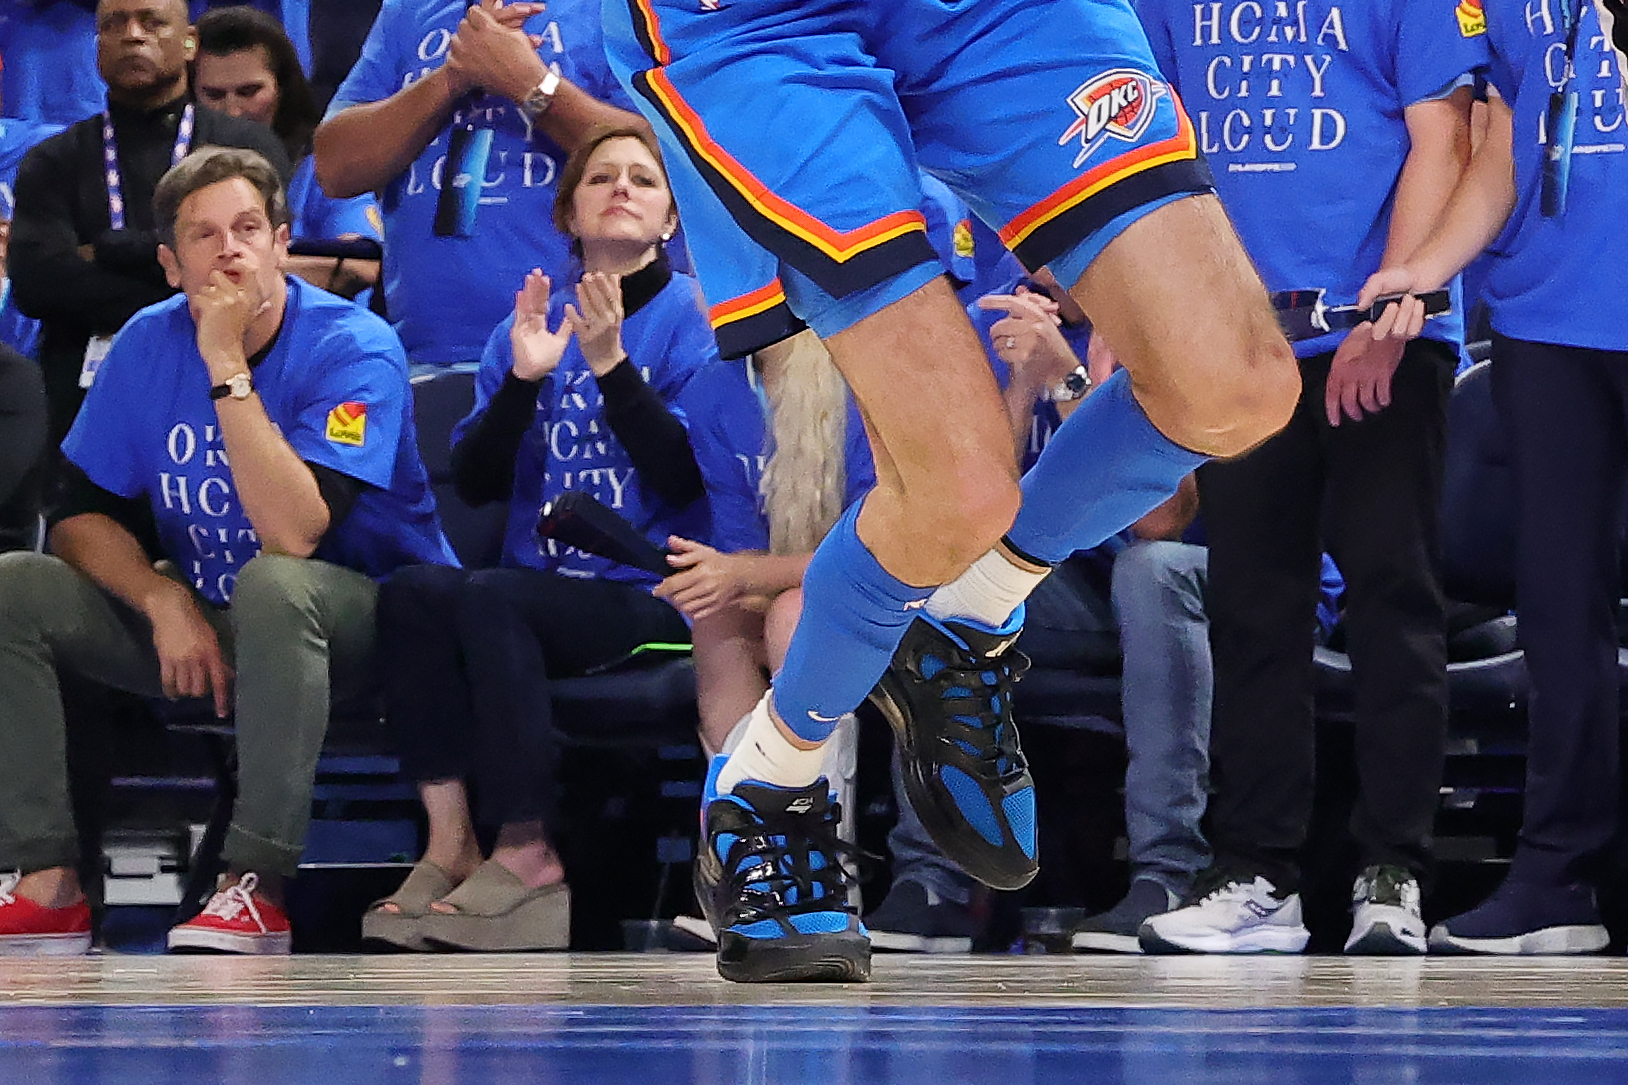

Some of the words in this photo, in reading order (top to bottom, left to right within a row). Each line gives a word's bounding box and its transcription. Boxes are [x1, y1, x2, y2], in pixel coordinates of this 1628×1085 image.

[1191, 0, 1350, 52] HOMA
[1205, 53, 1335, 101] CITY
[1085, 80, 1139, 143] OKC
[1199, 107, 1348, 154] LOUD
